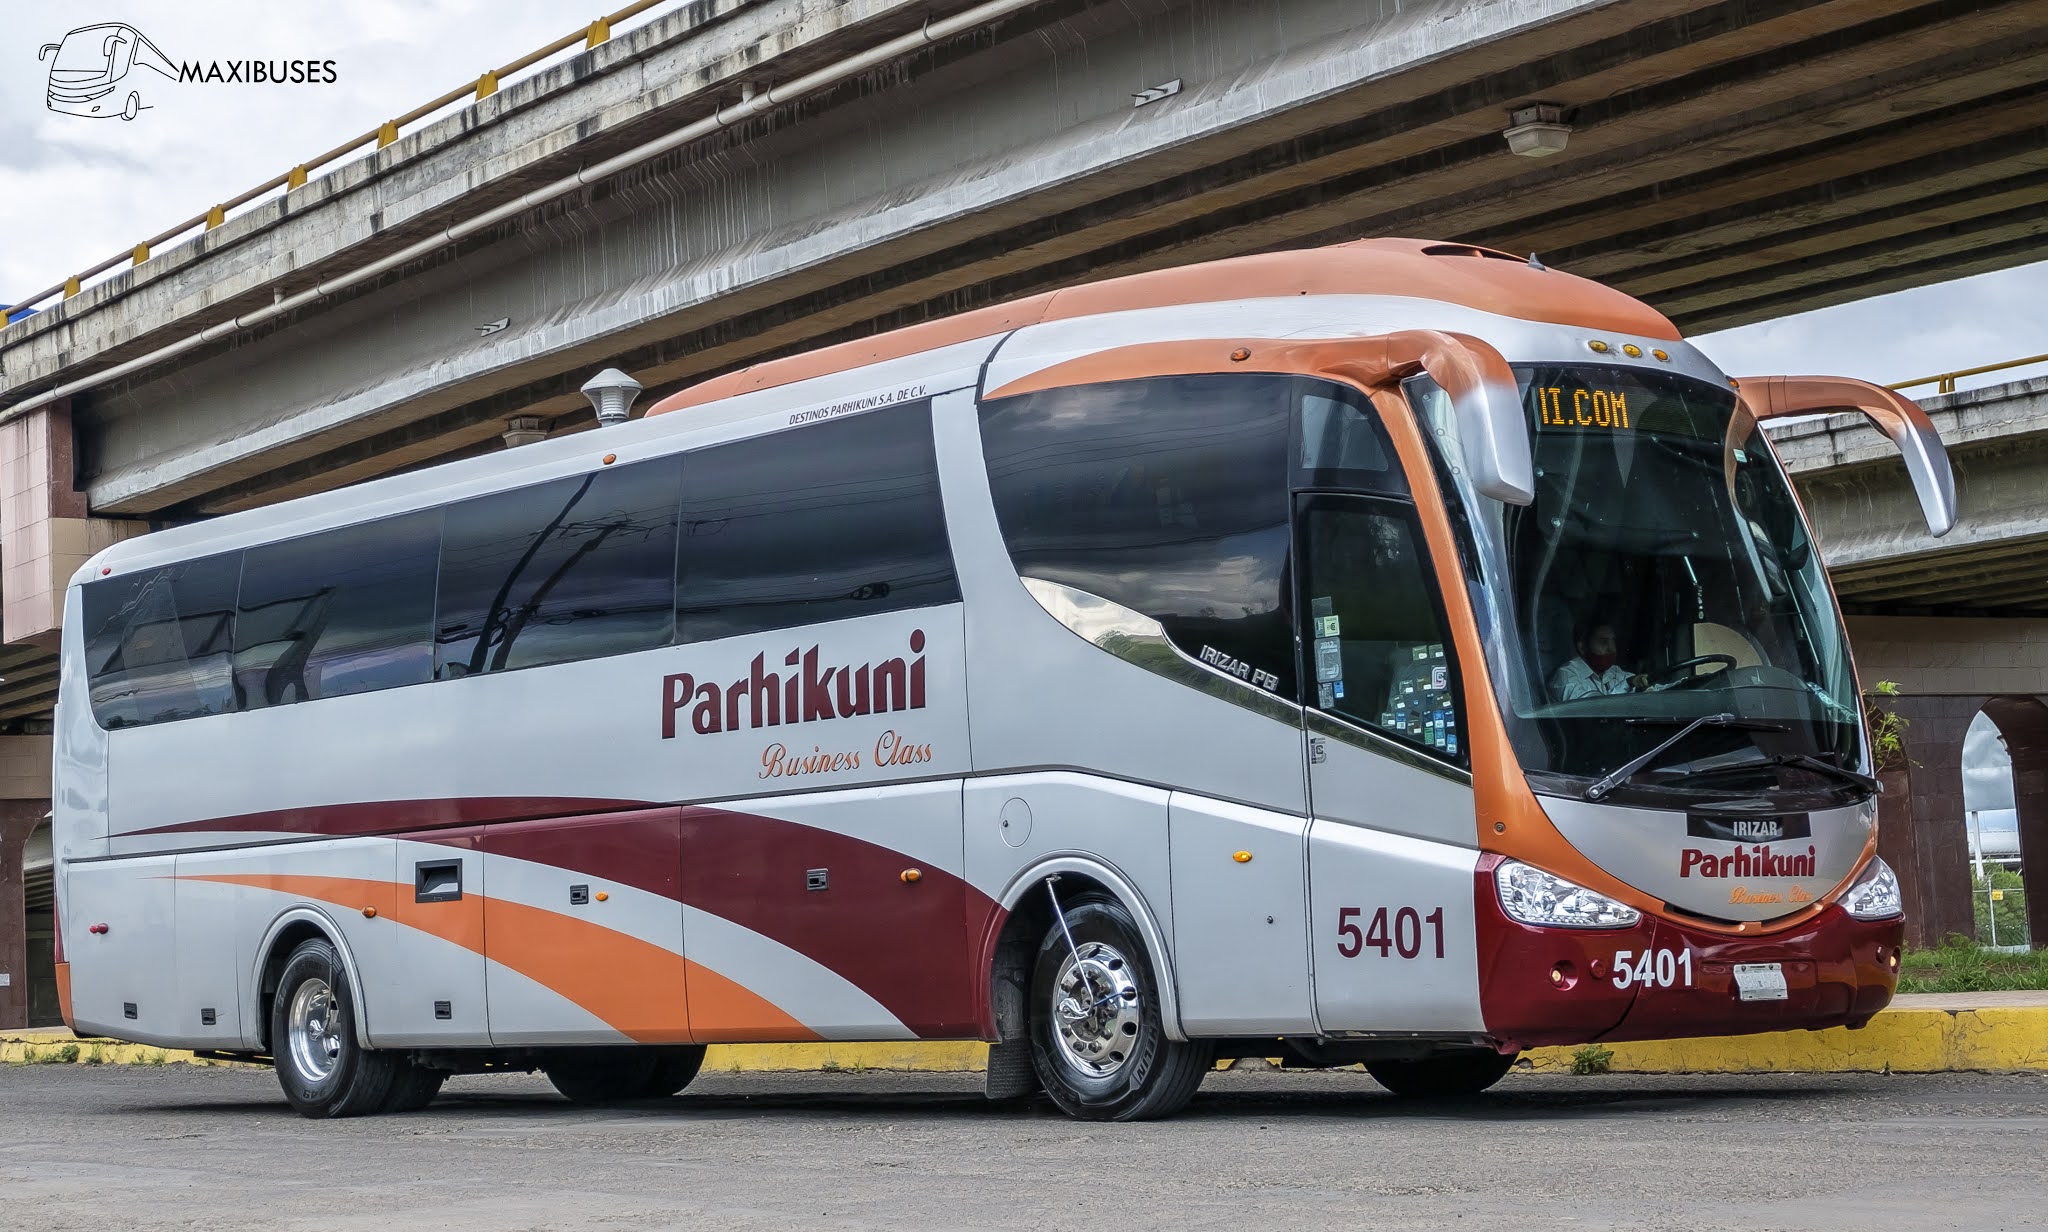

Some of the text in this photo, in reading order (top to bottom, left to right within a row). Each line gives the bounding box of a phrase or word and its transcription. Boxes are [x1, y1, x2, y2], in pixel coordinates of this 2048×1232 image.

[789, 384, 927, 425] DESTINOS PARHIKUNI S.A. DE C.V.
[1539, 387, 1629, 429] I.COM
[1199, 644, 1250, 680] IRIZAR
[661, 628, 926, 740] Parhikuni
[758, 729, 933, 780] Business Class
[1733, 821, 1778, 837] IRIZAR
[1679, 844, 1816, 878] Parhikuni
[1337, 905, 1445, 960] 5401
[1612, 947, 1692, 990] 5401
